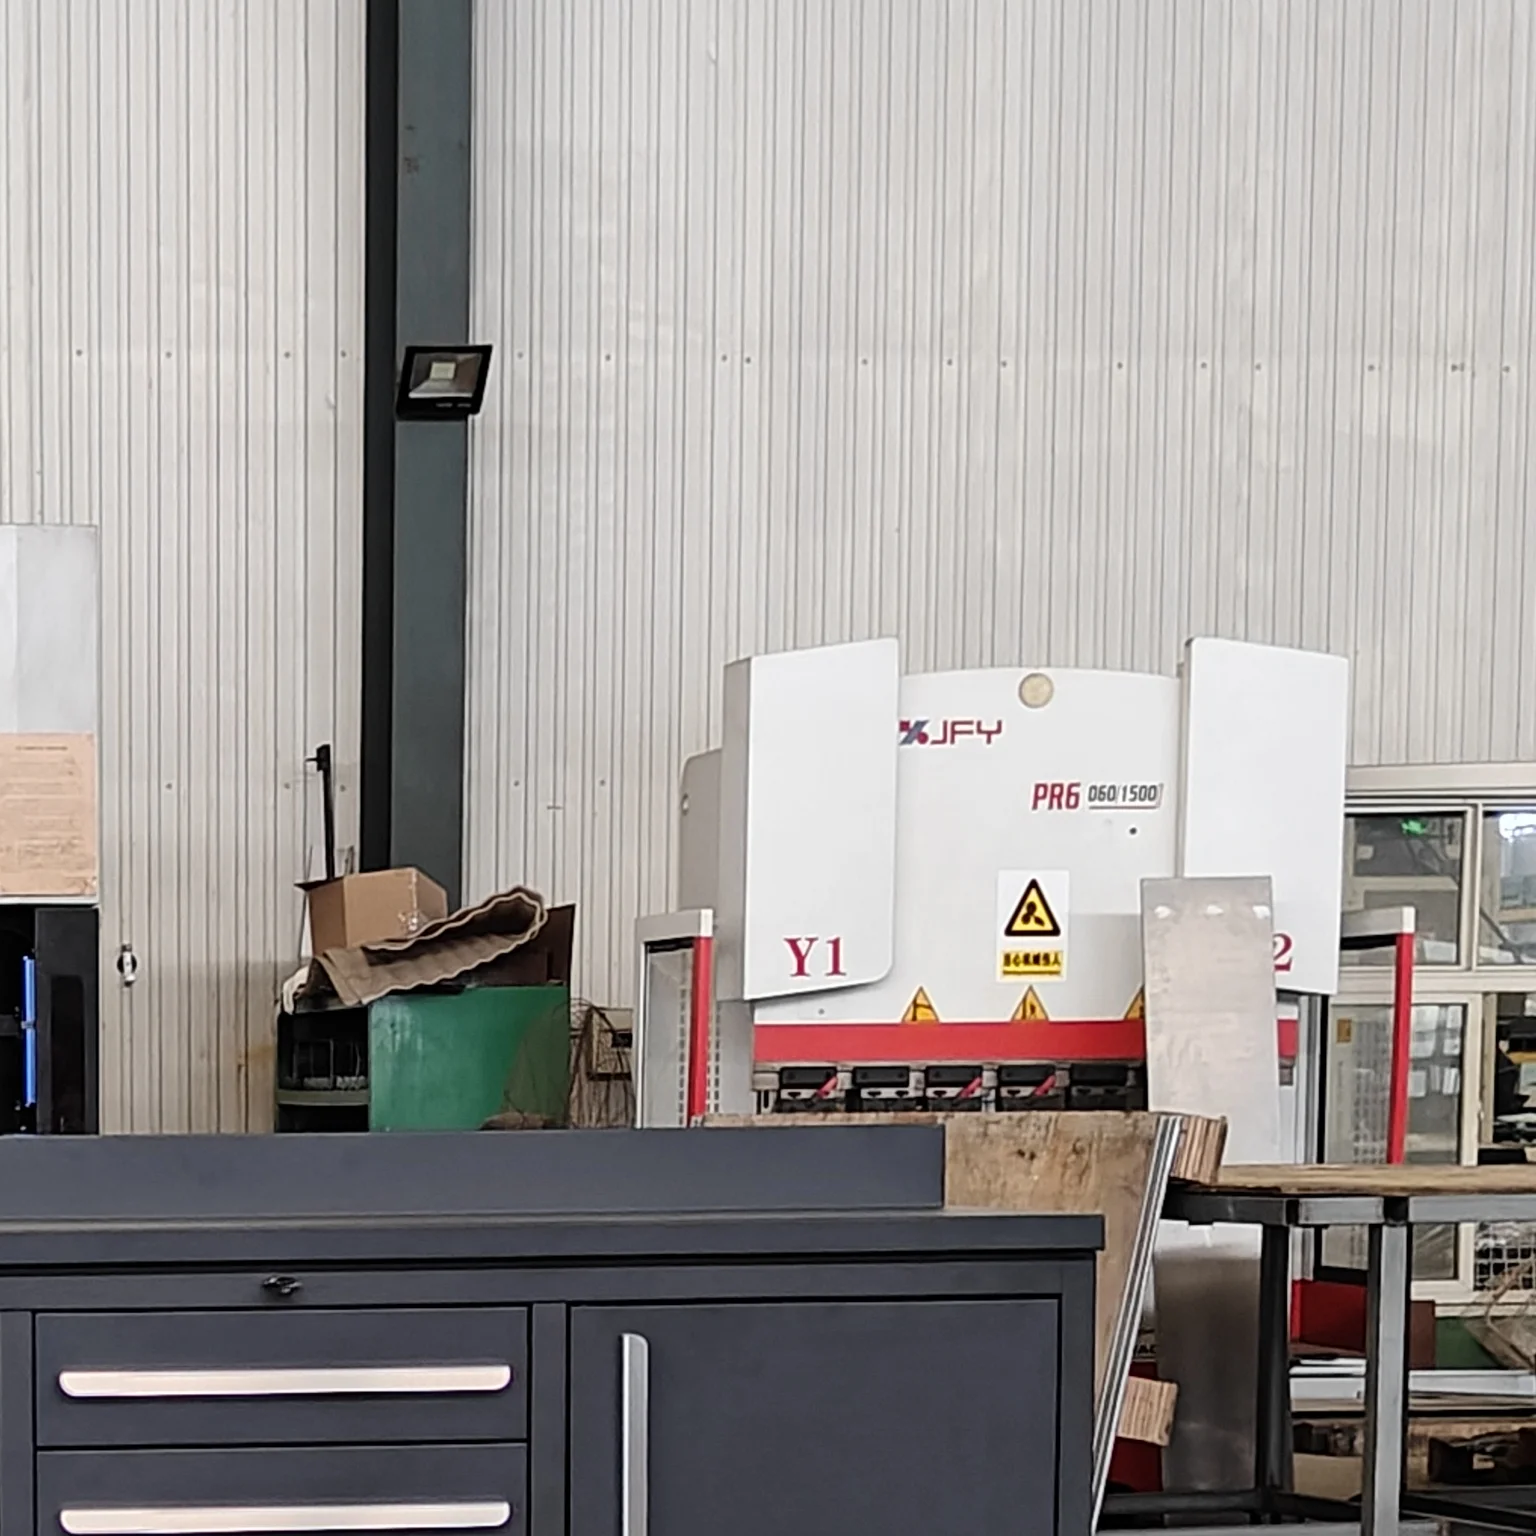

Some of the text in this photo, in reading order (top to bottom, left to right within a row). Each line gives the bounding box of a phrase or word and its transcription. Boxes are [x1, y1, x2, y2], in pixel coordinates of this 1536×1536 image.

[930, 720, 1003, 745] JFY
[1031, 782, 1081, 810] PR6
[783, 936, 847, 977] Y1
[1272, 932, 1292, 972] 2
